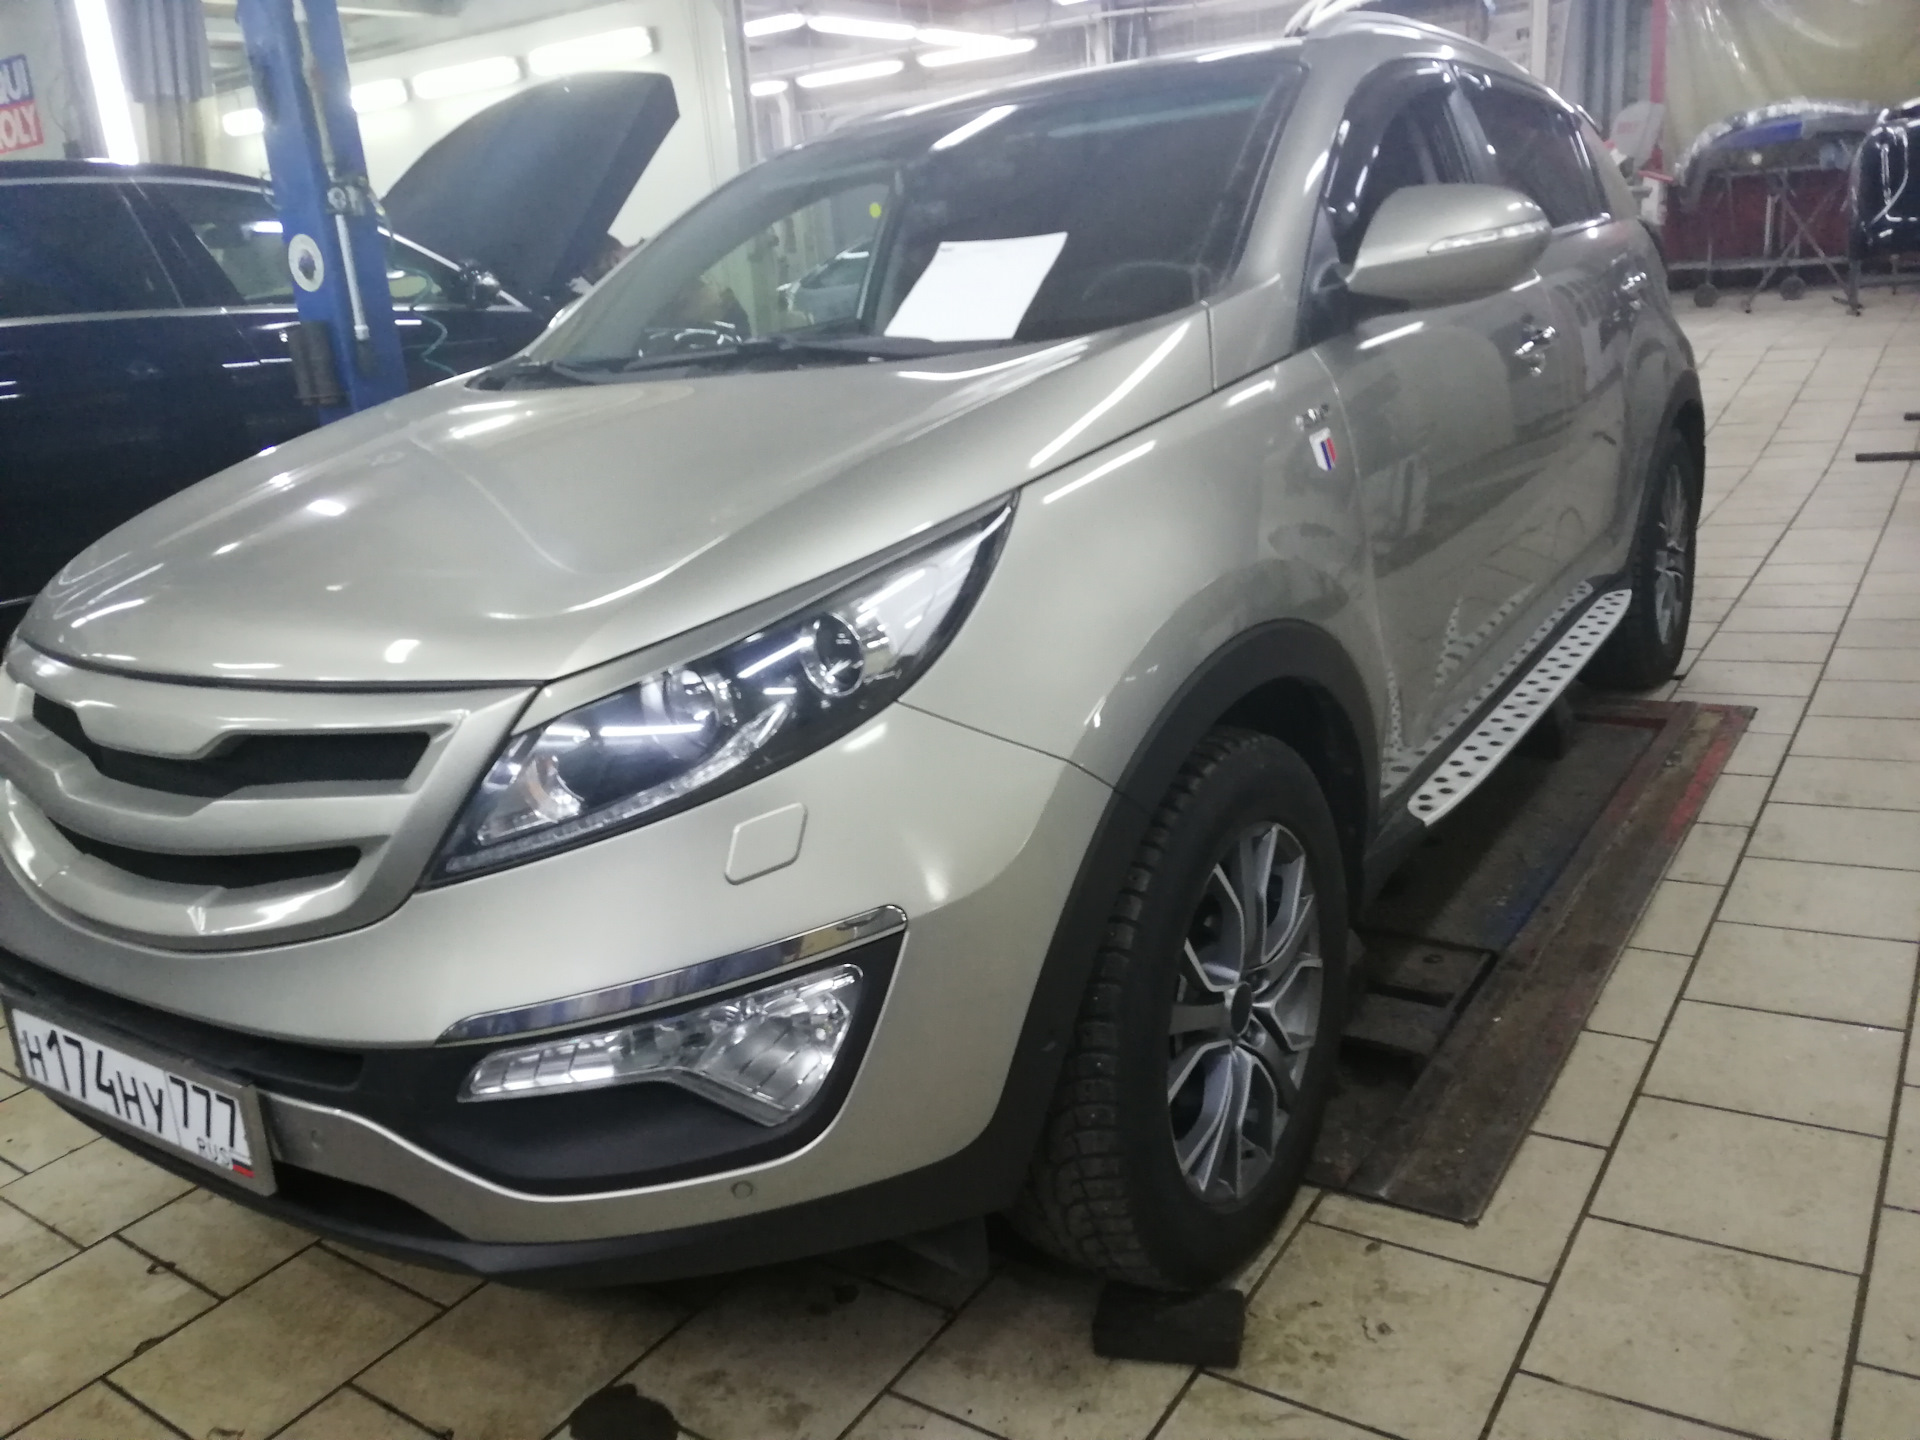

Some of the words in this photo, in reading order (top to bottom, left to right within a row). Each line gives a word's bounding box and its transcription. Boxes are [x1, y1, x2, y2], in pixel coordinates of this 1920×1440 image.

[0, 60, 30, 103] UI
[0, 104, 38, 149] OLY
[169, 1075, 236, 1148] 777
